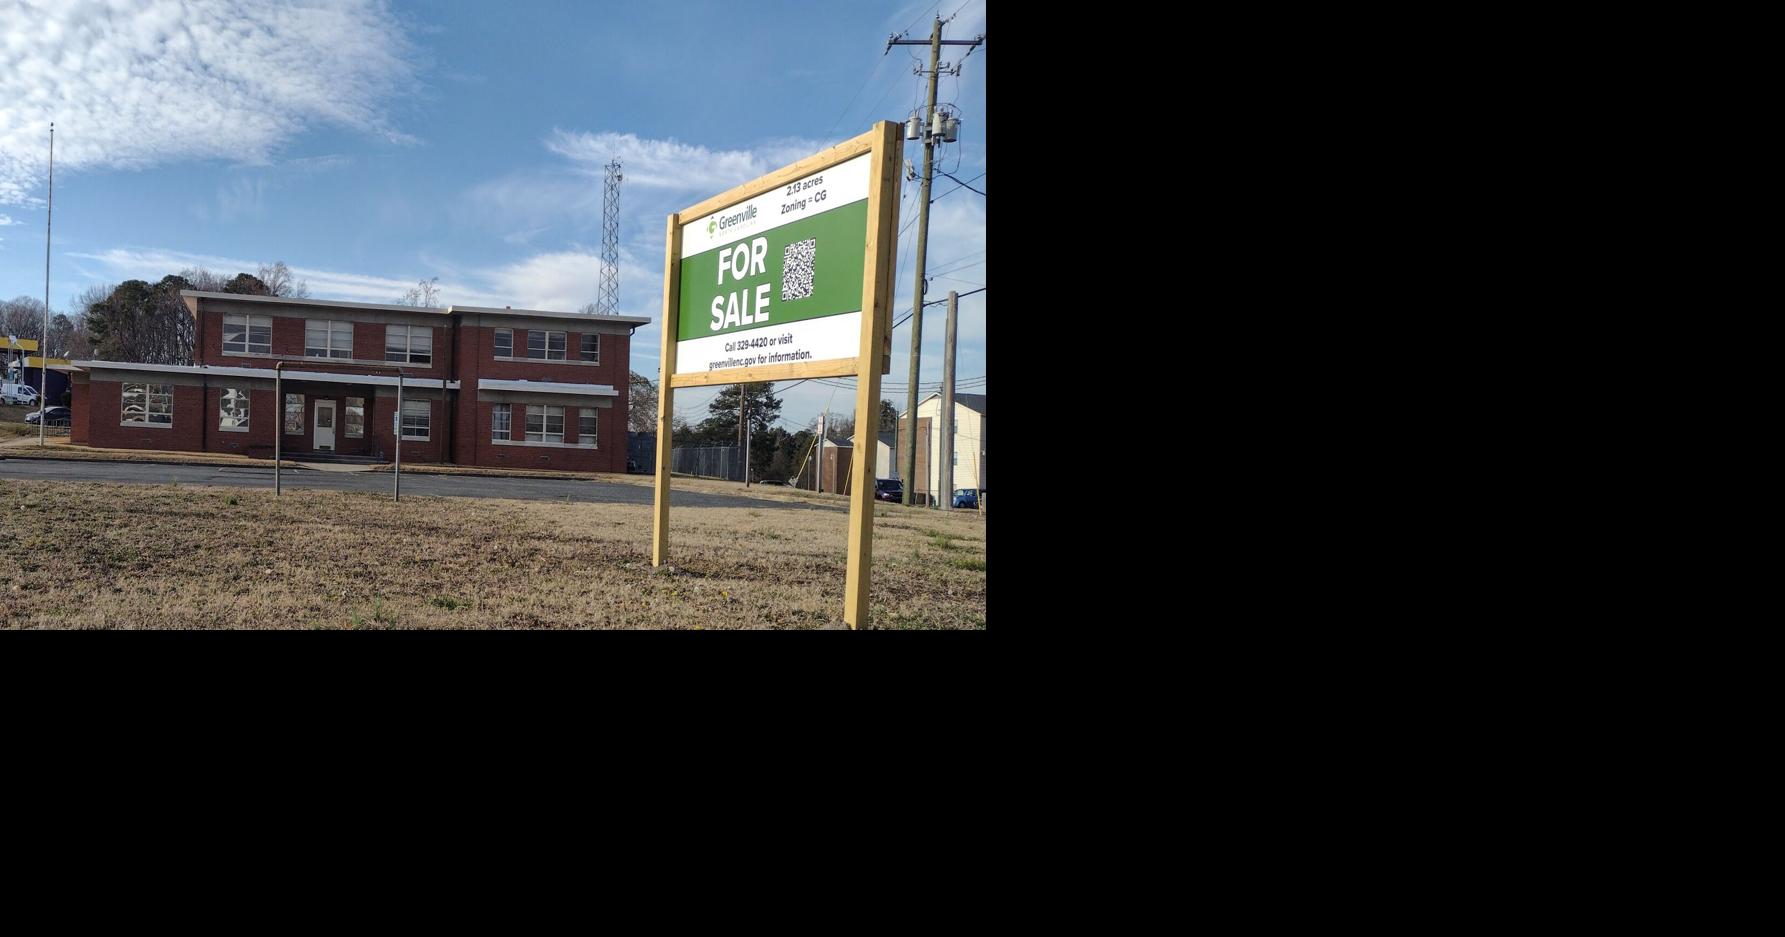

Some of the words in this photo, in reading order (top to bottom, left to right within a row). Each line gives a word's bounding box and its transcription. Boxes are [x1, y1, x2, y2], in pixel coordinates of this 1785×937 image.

[802, 175, 823, 190] acres
[781, 199, 806, 215] Zoning
[814, 189, 827, 203] CG
[719, 204, 757, 230] Greenville
[718, 236, 768, 285] FOR
[710, 282, 771, 331] SALE
[725, 341, 736, 352] Call
[737, 337, 768, 350] 329-4420
[769, 337, 778, 347] or
[778, 333, 793, 344] visit
[709, 357, 756, 371] greenvillenc.gov
[757, 354, 767, 364] for
[768, 349, 812, 362] information.
